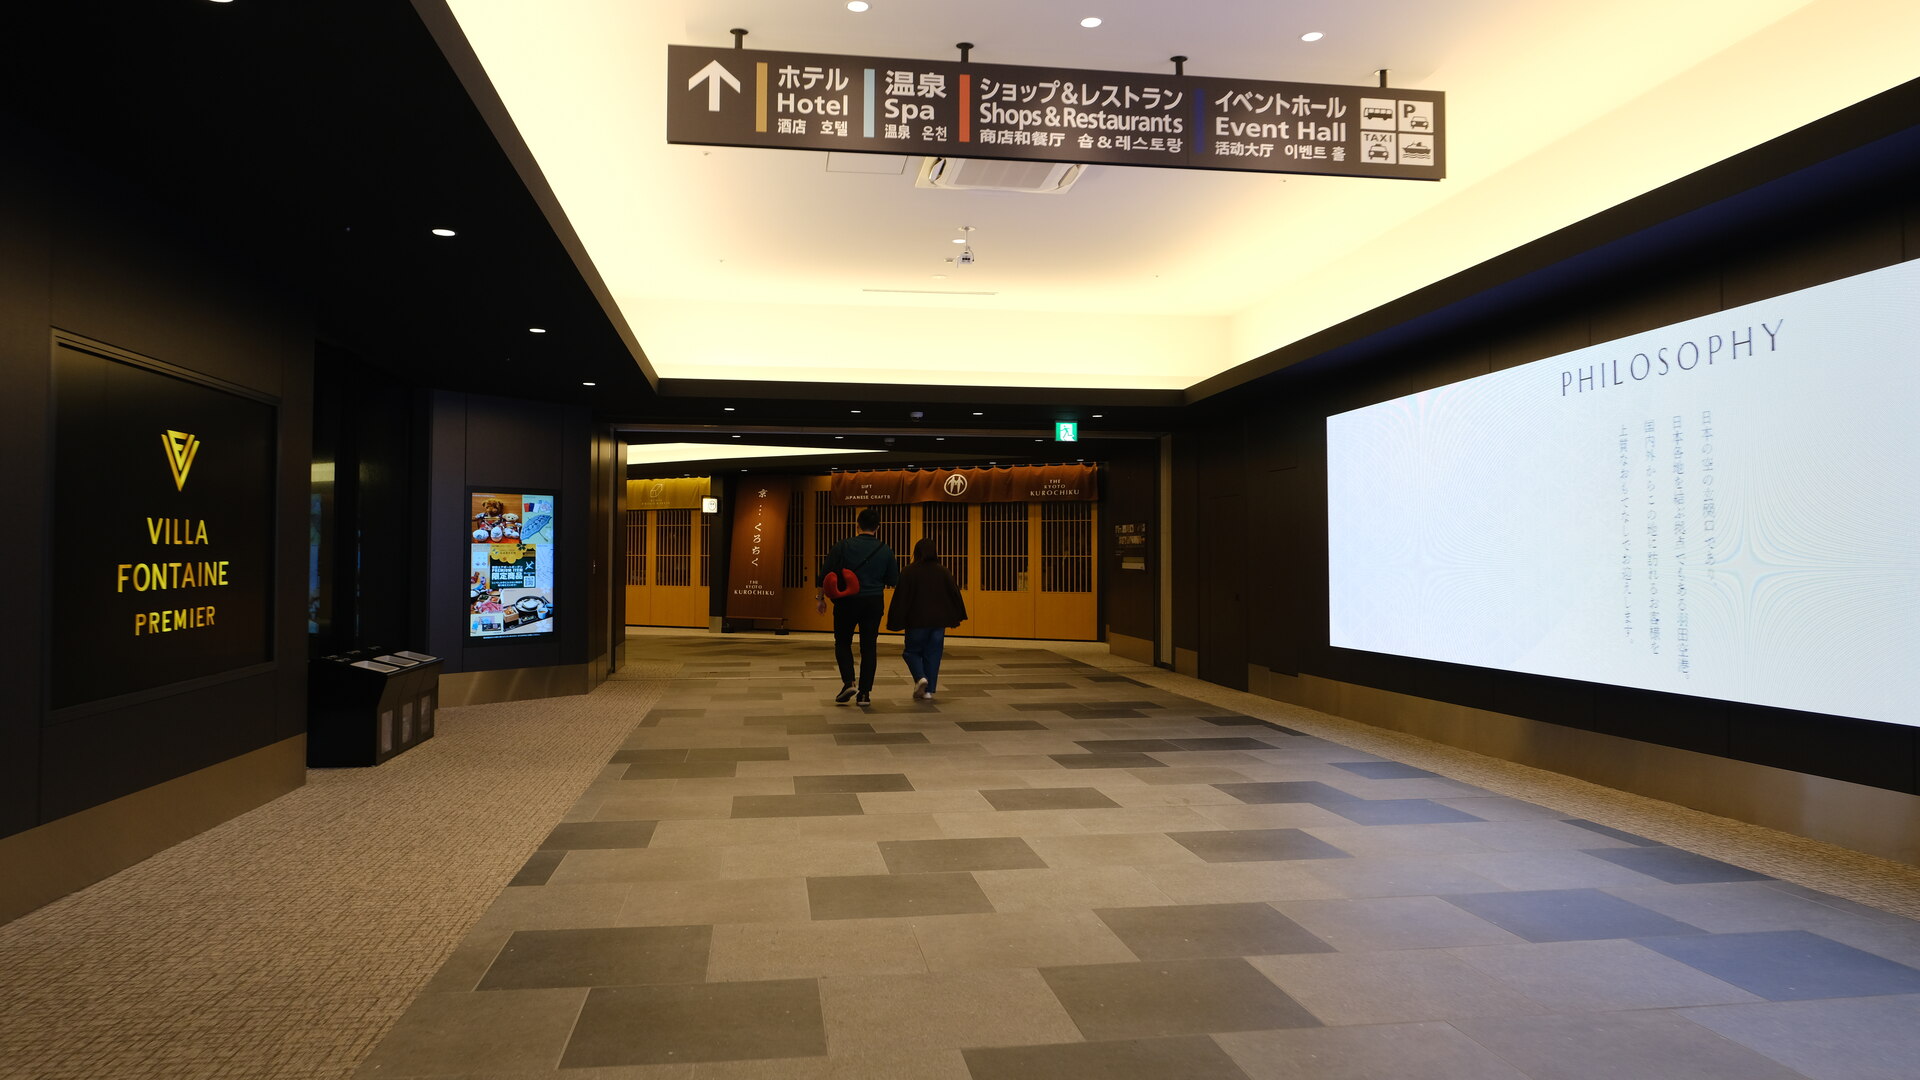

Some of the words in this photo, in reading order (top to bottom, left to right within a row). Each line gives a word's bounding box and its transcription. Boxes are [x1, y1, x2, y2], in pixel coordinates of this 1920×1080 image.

[777, 65, 850, 92] ホテル
[884, 70, 948, 99] 温泉
[776, 92, 849, 117] Hotel
[884, 98, 936, 122] Spa
[1214, 90, 1348, 119] イベントホール
[777, 117, 807, 136] 酒店
[819, 118, 849, 138] 호텔
[979, 101, 1042, 130] Shops
[1044, 106, 1061, 128] &
[1063, 106, 1184, 134] Restaurants
[1215, 116, 1290, 139] Event
[1297, 121, 1347, 142] Hall
[884, 123, 911, 140] 温泉
[921, 124, 948, 142] 온천
[979, 128, 1066, 148] 商店和餐厅
[1115, 134, 1184, 153] 레스토랑
[1363, 132, 1394, 143] TAXI
[1214, 140, 1275, 158] 活动大厅
[1284, 143, 1328, 160] 이벤트
[1561, 317, 1785, 397] PHILOSOPHY
[1029, 488, 1080, 497] KUROCHIKU
[146, 516, 209, 546] VILLA
[117, 560, 230, 593] FONTAINE
[134, 605, 217, 637] PREMIER
